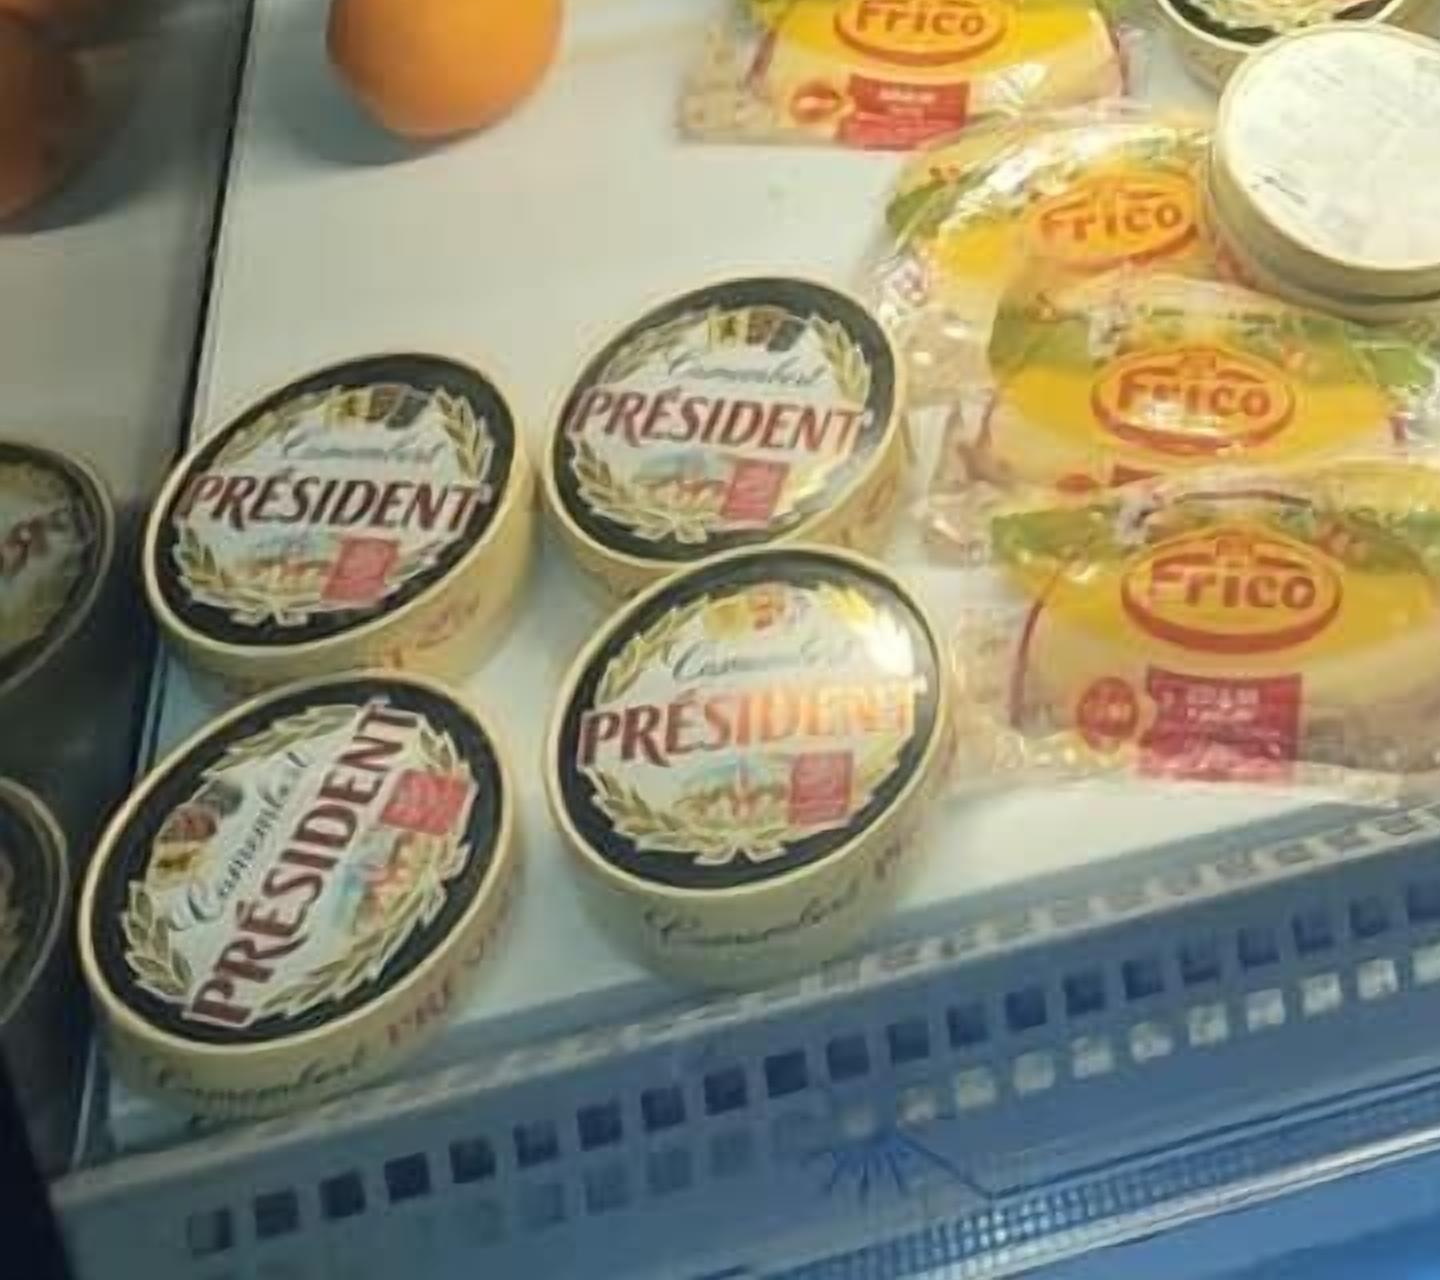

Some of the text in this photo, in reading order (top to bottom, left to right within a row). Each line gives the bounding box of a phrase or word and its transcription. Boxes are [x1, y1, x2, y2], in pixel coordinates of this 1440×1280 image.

[856, 3, 986, 37] Frico
[1041, 202, 1181, 241] Frico
[571, 387, 863, 455] PRÉSIDENT
[1118, 380, 1271, 418] Frico
[183, 467, 481, 531] PRÉSIDENT
[1150, 565, 1317, 609] Frico
[580, 678, 918, 767] PRÉSIDENT
[192, 703, 418, 1023] PRÉSIDENT
